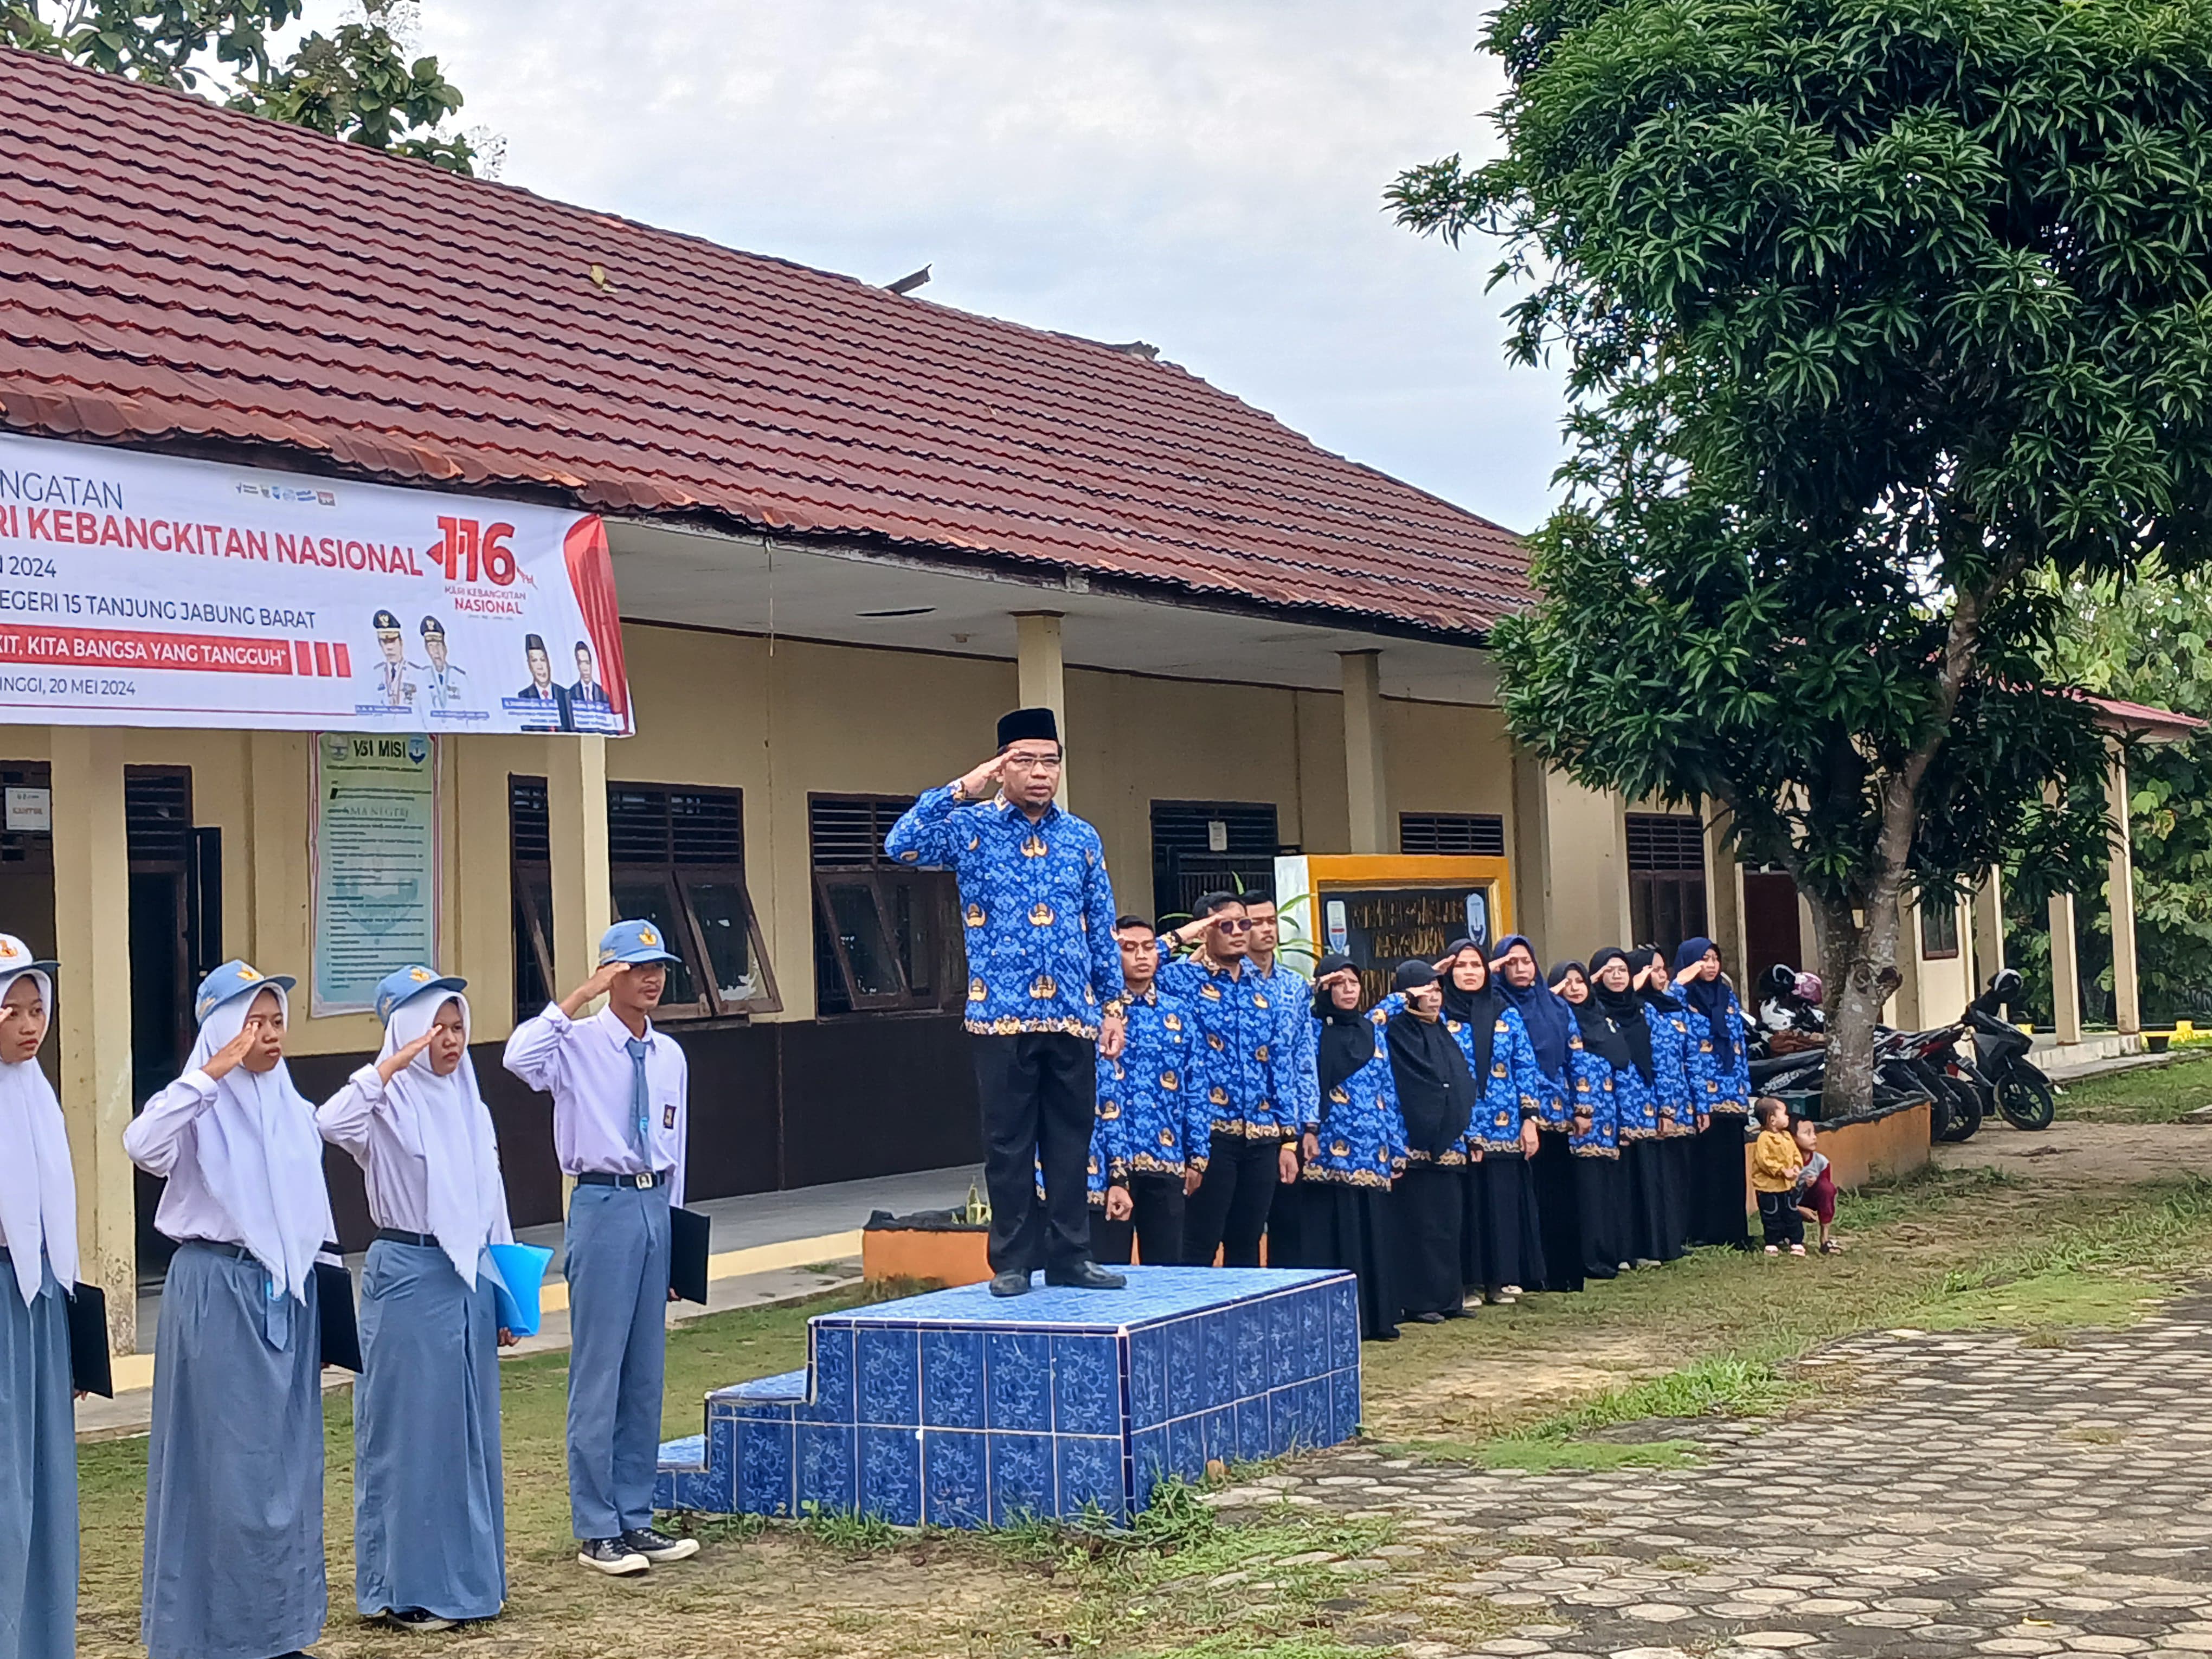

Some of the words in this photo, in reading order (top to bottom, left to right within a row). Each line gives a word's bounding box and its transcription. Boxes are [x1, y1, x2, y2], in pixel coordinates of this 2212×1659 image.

[28, 507, 268, 561] KEBANGKITAN
[275, 532, 423, 576] NASIONAL
[437, 516, 516, 586] 116
[9, 556, 56, 577] 2024
[63, 594, 81, 614] 15
[85, 595, 176, 620] TANJUNG
[181, 602, 255, 625] JABUNG
[260, 608, 316, 629] BARAT
[454, 597, 524, 615] NASIONAL
[28, 635, 69, 657] KITA
[74, 638, 148, 660] BANGSA
[150, 642, 198, 663] YANG
[49, 678, 67, 693] 20
[71, 679, 98, 695] MEI
[101, 680, 136, 696] 2024
[378, 740, 406, 758] MISI
